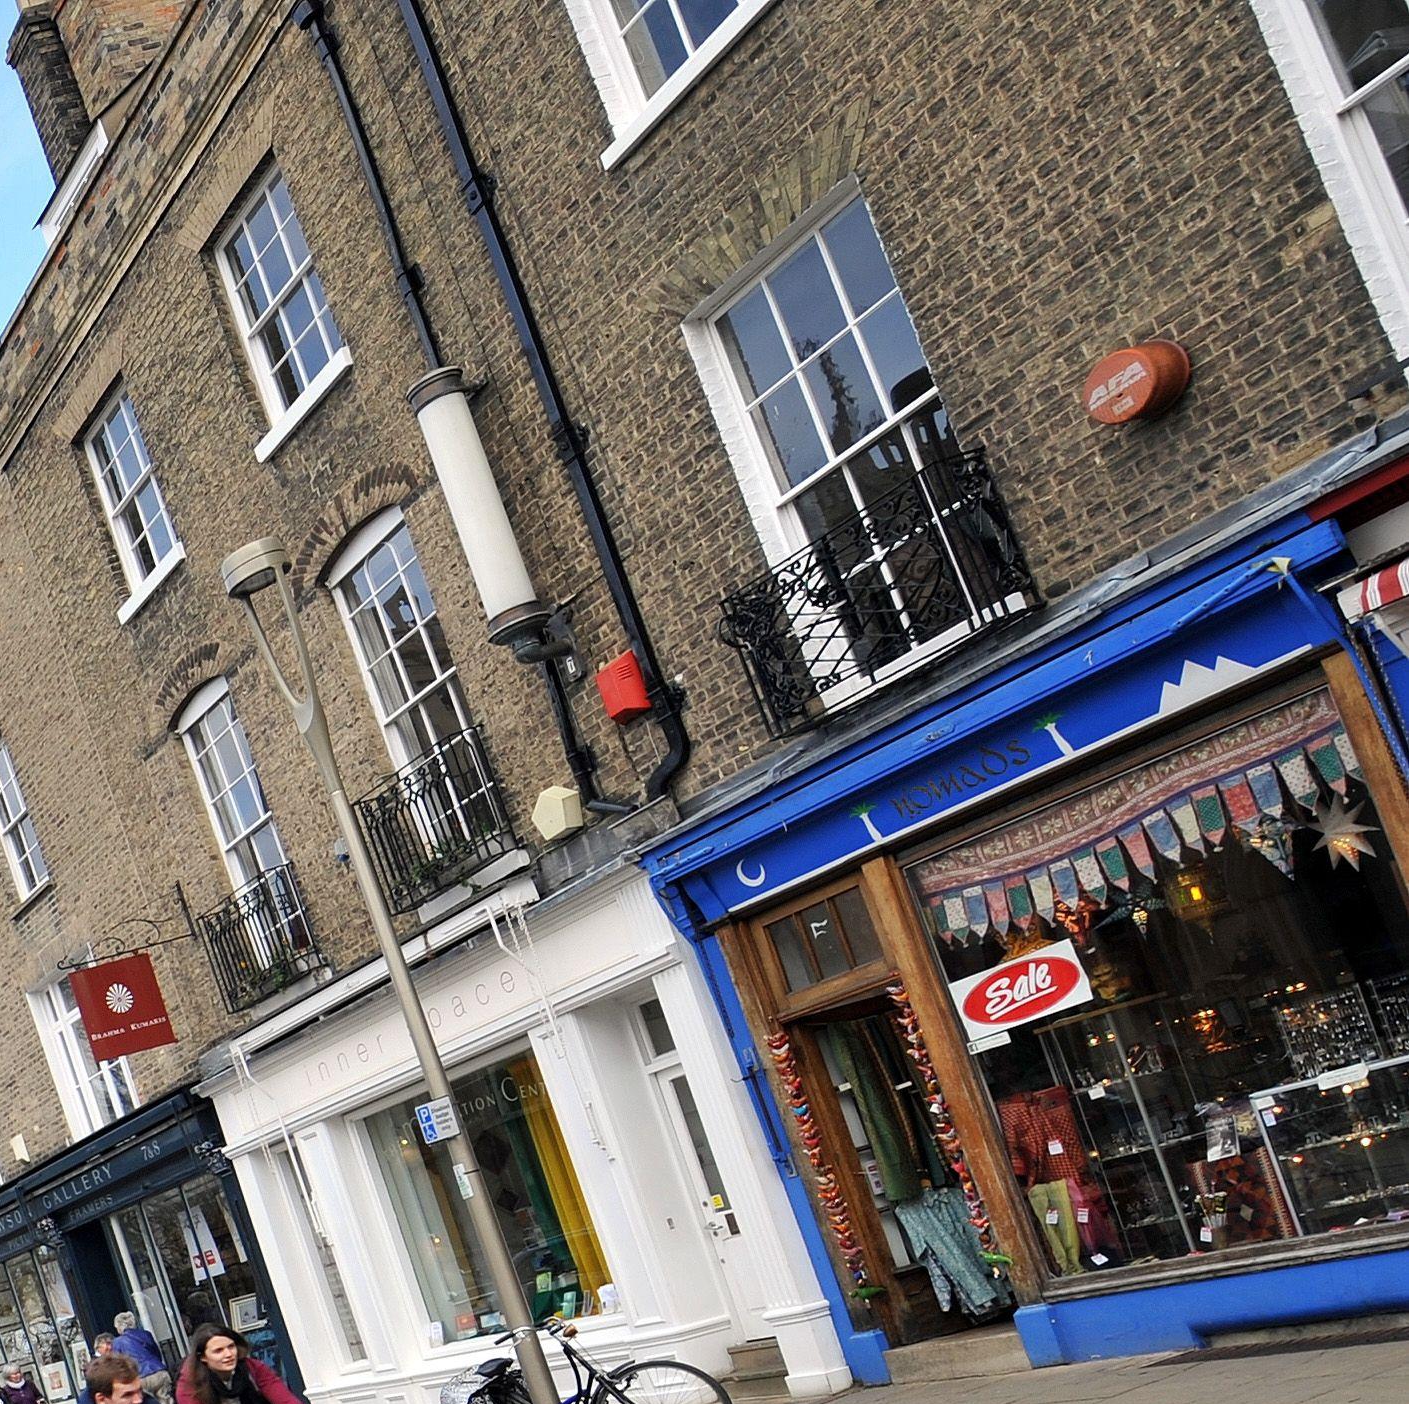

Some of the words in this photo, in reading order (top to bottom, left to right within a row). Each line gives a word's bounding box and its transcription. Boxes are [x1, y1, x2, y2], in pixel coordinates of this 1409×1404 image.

[985, 962, 1052, 1015] Sale
[304, 1033, 383, 1086] inner
[427, 971, 516, 1037] pace
[42, 1163, 113, 1211] GALLERY
[139, 1139, 161, 1161] 7&8
[69, 1193, 113, 1222] FRAMERS
